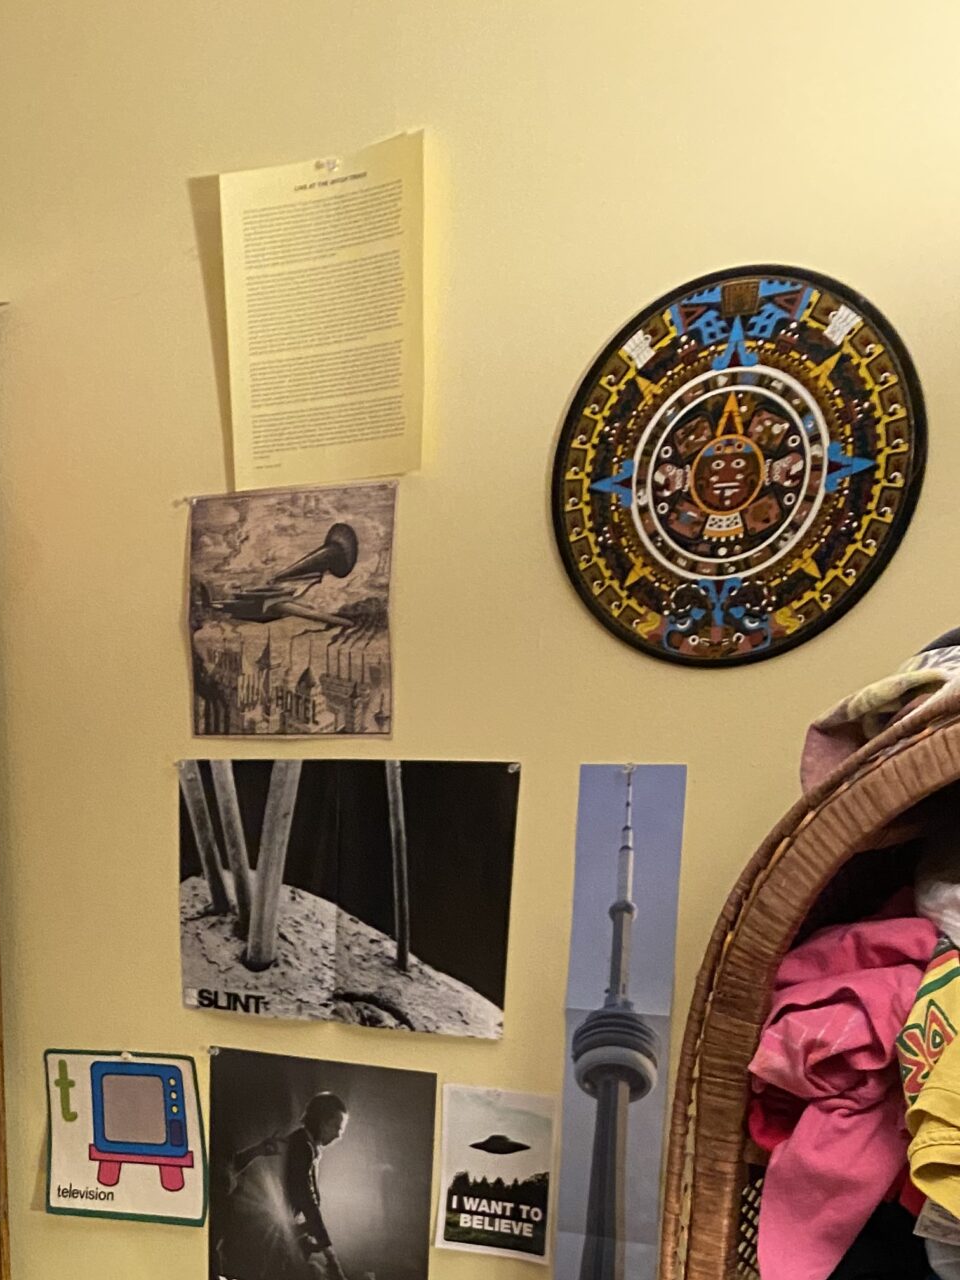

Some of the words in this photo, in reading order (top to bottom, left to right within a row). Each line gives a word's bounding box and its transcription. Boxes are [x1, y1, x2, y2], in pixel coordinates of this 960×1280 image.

[197, 988, 265, 1014] SLINT
[54, 1059, 78, 1122] t
[56, 1183, 115, 1201] television
[451, 1195, 458, 1208] I
[463, 1196, 514, 1216] WANT
[519, 1206, 543, 1221] TO
[459, 1213, 534, 1237] BELIEVE
